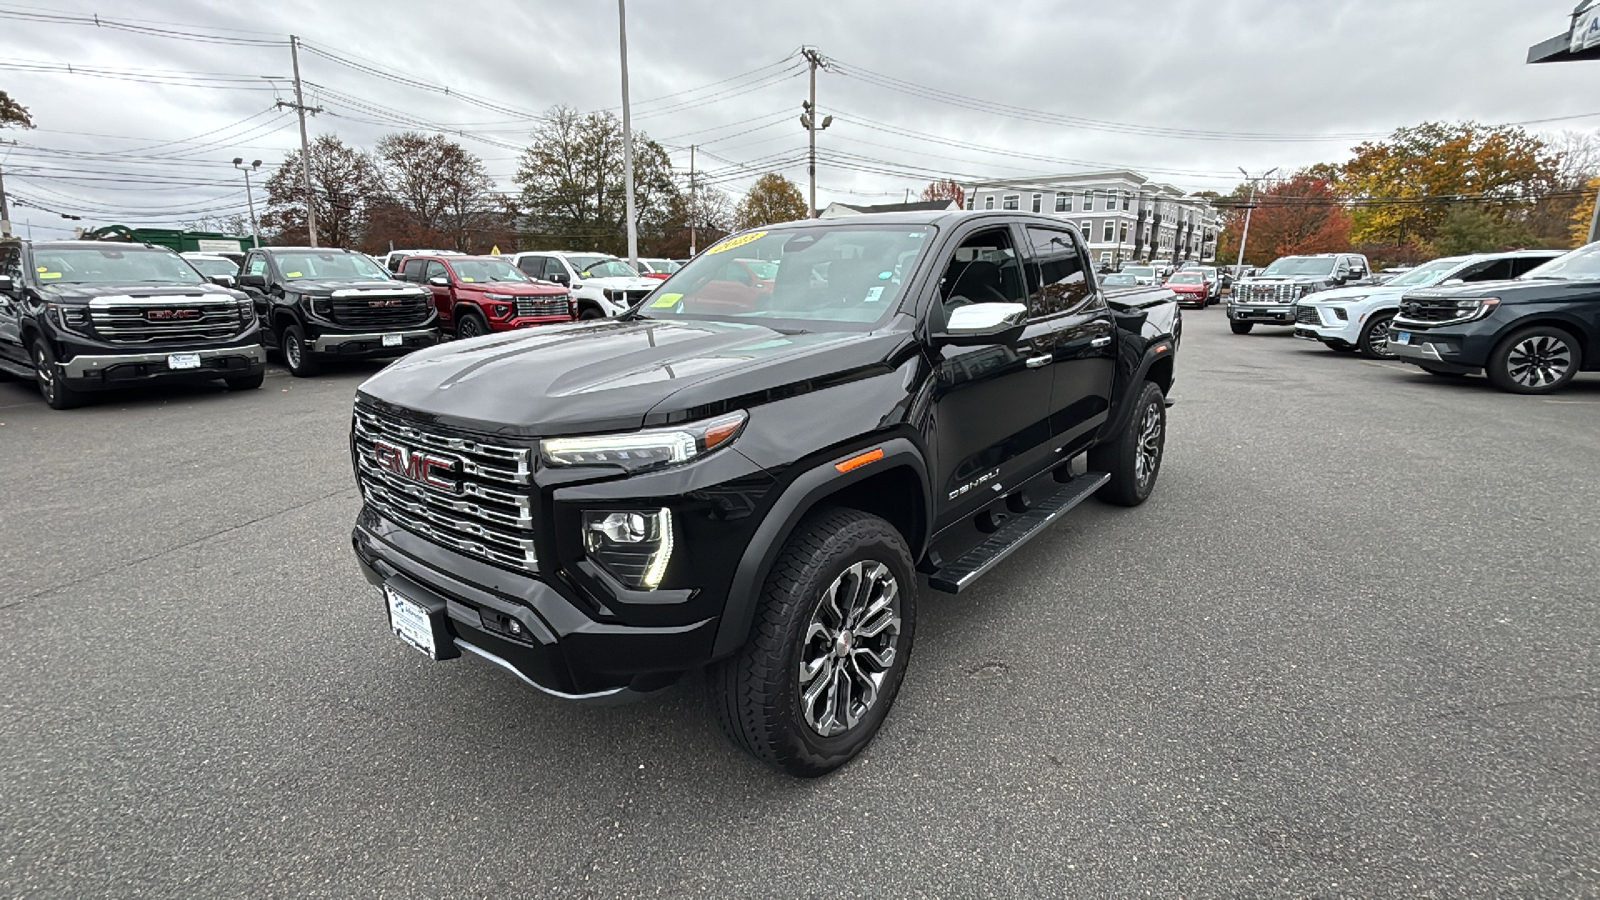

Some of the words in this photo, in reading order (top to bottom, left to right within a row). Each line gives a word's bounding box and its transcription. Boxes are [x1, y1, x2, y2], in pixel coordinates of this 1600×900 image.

[1589, 17, 1600, 33] A
[148, 309, 200, 318] GMC
[375, 439, 456, 492] GMC
